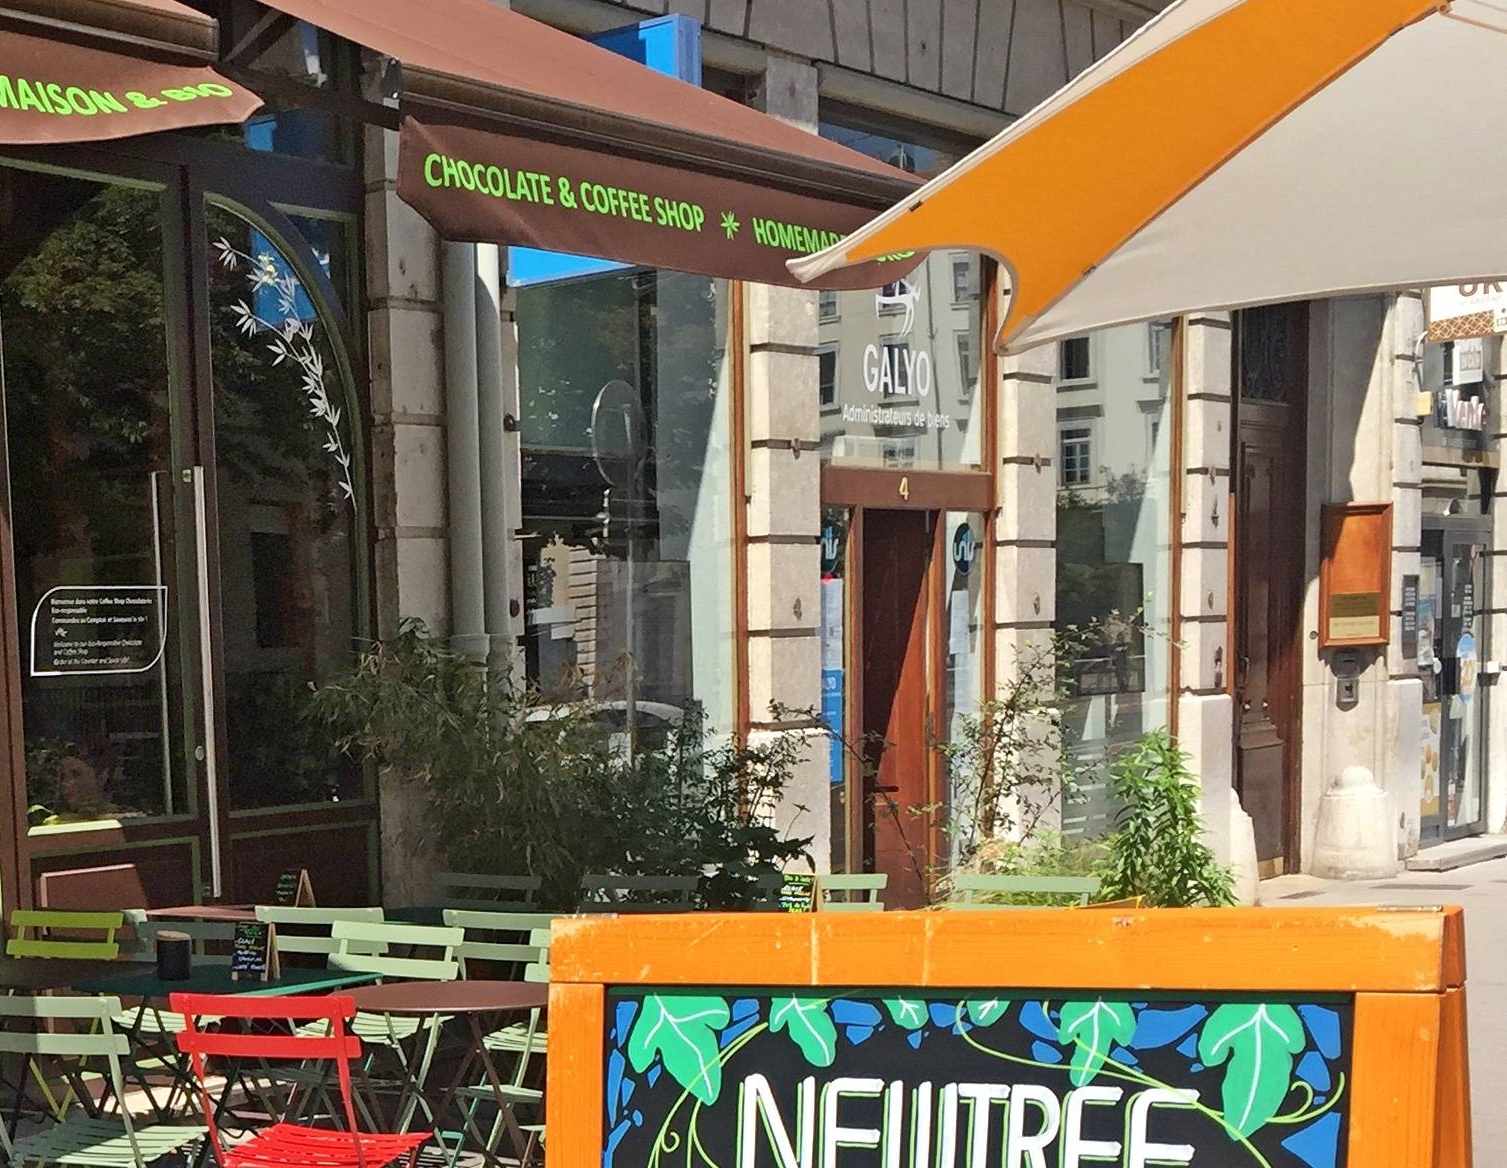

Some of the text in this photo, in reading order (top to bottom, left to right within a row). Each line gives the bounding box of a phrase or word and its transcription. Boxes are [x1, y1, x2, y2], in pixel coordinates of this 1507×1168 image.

[126, 91, 169, 109] &
[161, 83, 234, 101] BIO
[424, 153, 705, 232] CHOCOLATE & COFFEE SHOP
[752, 217, 848, 253] HOMEMAD
[863, 344, 930, 397] GALYO
[842, 403, 950, 428] Administrateurs de biens
[899, 477, 909, 500] 4
